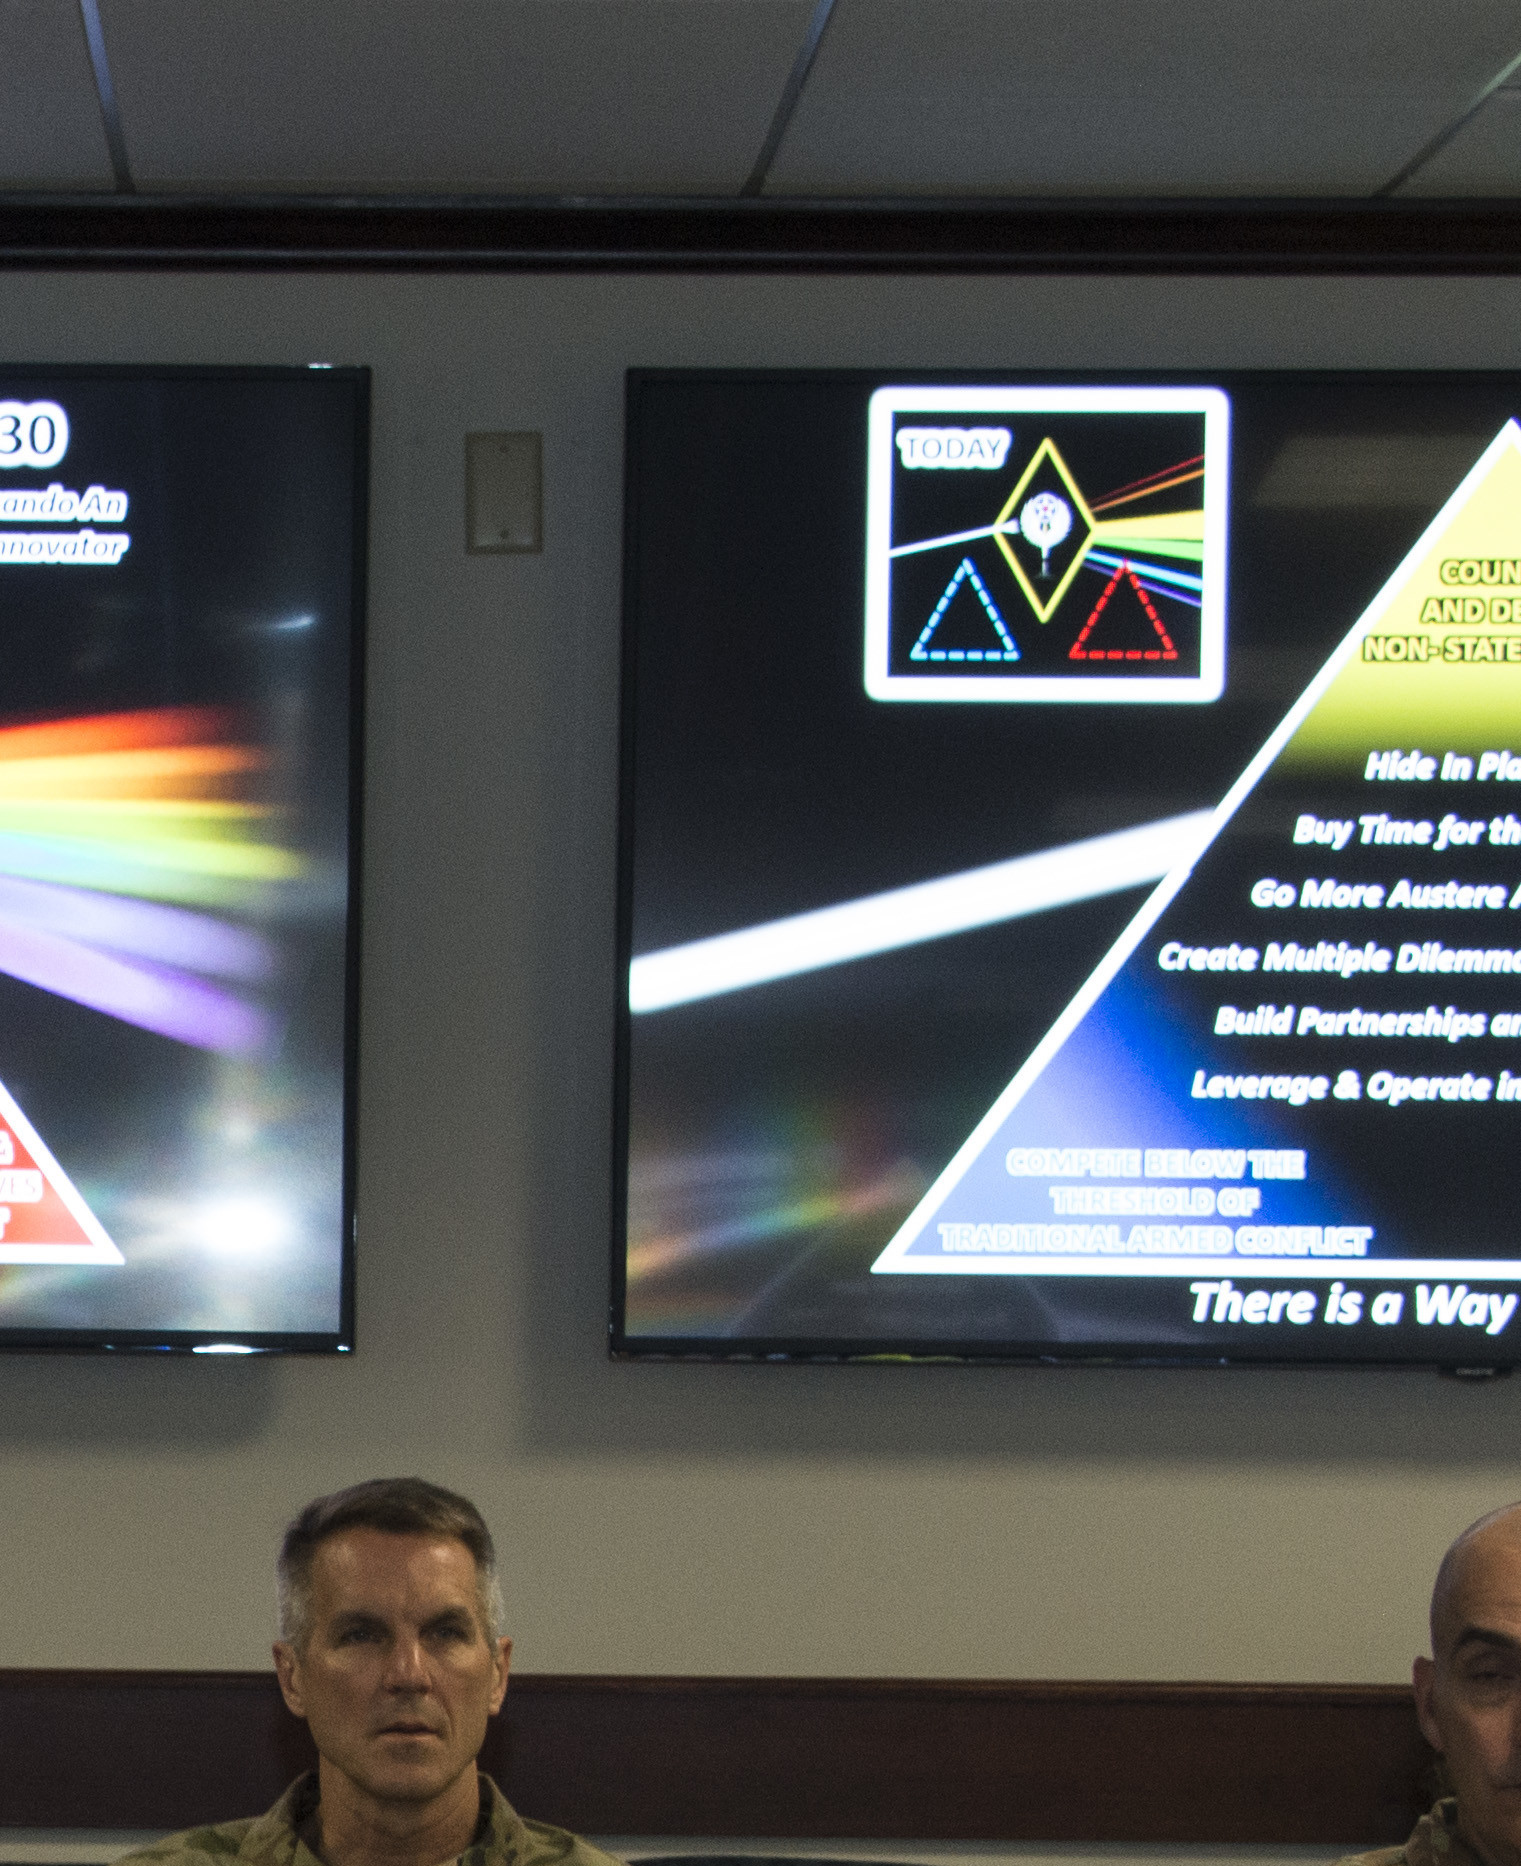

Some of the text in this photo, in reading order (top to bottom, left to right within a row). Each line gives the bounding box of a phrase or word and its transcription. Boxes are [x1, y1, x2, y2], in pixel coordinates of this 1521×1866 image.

[902, 433, 1006, 463] TODAY
[80, 488, 126, 518] An
[1421, 598, 1486, 624] AND
[1365, 750, 1436, 780] Hide
[1441, 752, 1472, 780] In
[1293, 815, 1353, 850] Buy
[1359, 814, 1433, 844] Time
[1433, 814, 1485, 850] for
[1251, 879, 1296, 907] Go
[1300, 879, 1384, 908] More
[1386, 880, 1506, 909] Austere
[1158, 942, 1258, 971] Create
[1263, 942, 1391, 978] Multiple
[1214, 1005, 1294, 1035] Build
[1297, 1006, 1486, 1042] Partnerships
[1191, 1070, 1329, 1105] Leverage
[1333, 1070, 1360, 1099] &
[1367, 1072, 1492, 1106] Operate
[1007, 1146, 1305, 1180] COMPETE BELOW THE
[1049, 1184, 1260, 1217] THRESHOLD OF
[938, 1222, 1372, 1256] TRADITIONAL ARMED CONFLICT
[1190, 1280, 1316, 1323] There
[1324, 1282, 1362, 1324] is
[1371, 1293, 1403, 1324] a
[1416, 1285, 1517, 1334] Way
